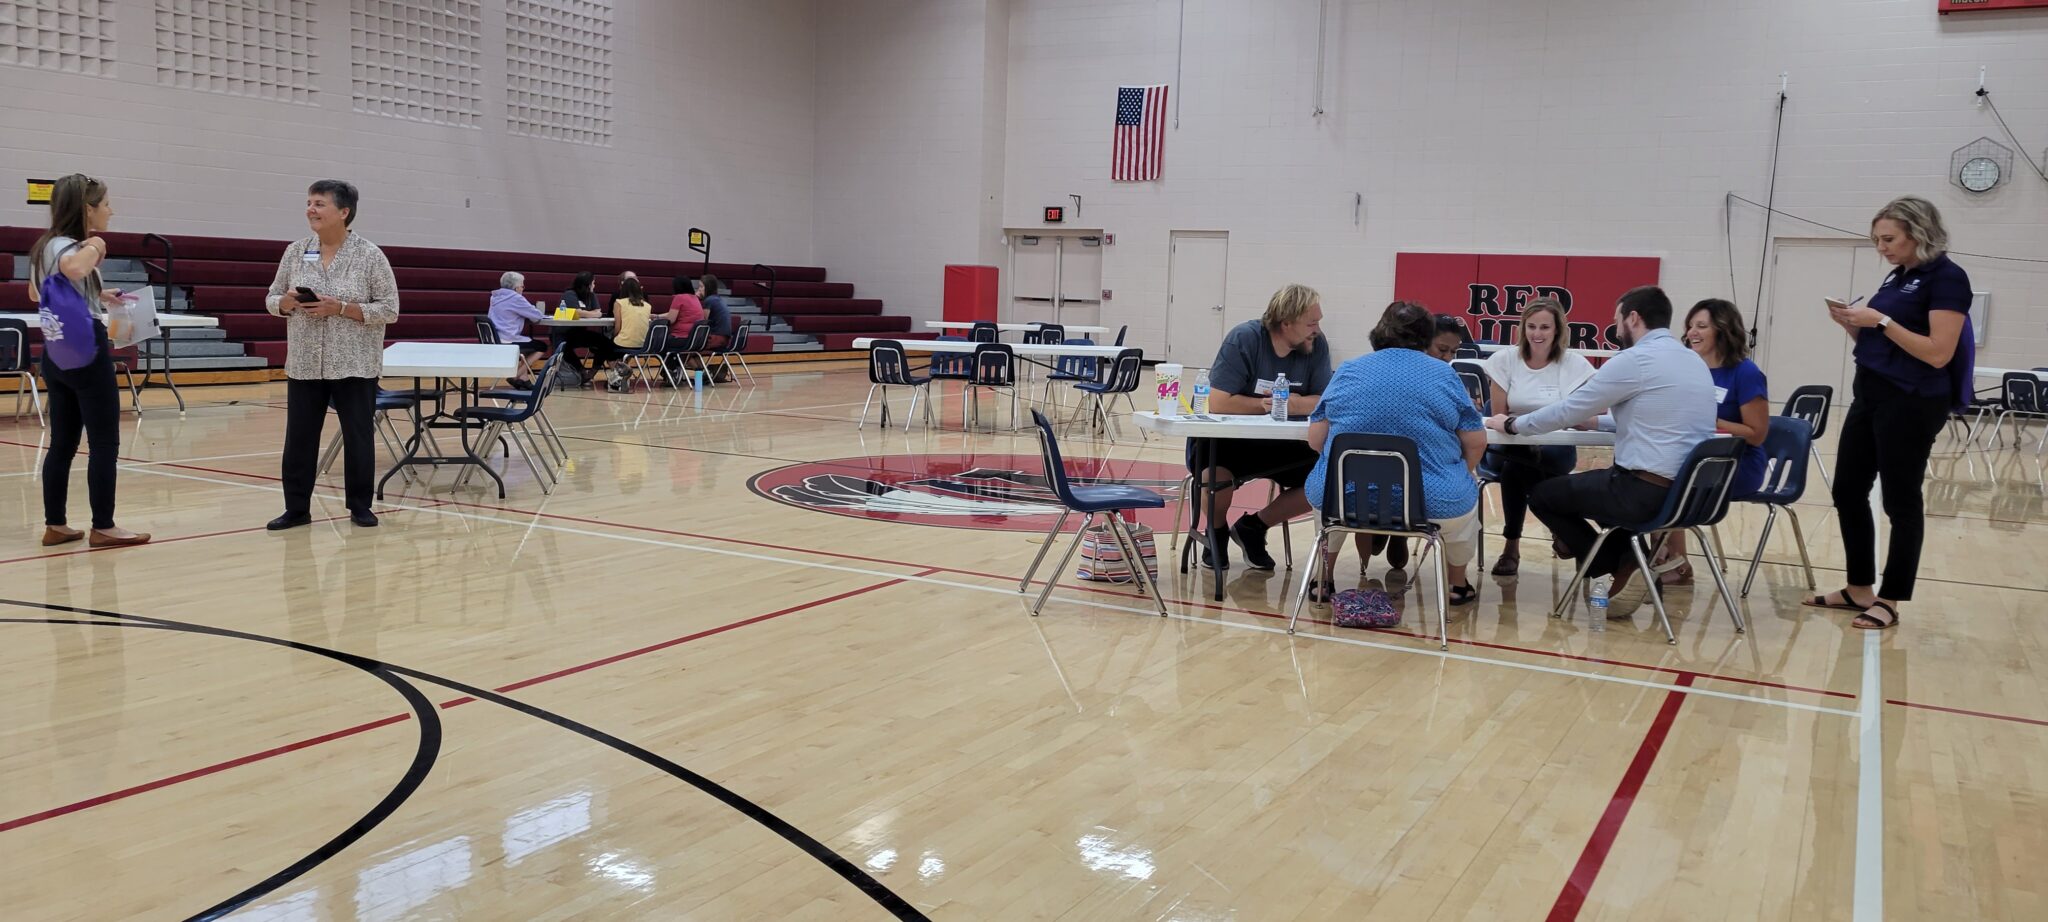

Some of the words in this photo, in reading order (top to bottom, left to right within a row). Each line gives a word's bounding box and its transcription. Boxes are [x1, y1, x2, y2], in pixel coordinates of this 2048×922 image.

[1047, 209, 1060, 220] EXIT
[1466, 283, 1574, 317] RED
[1157, 381, 1179, 397] 44
